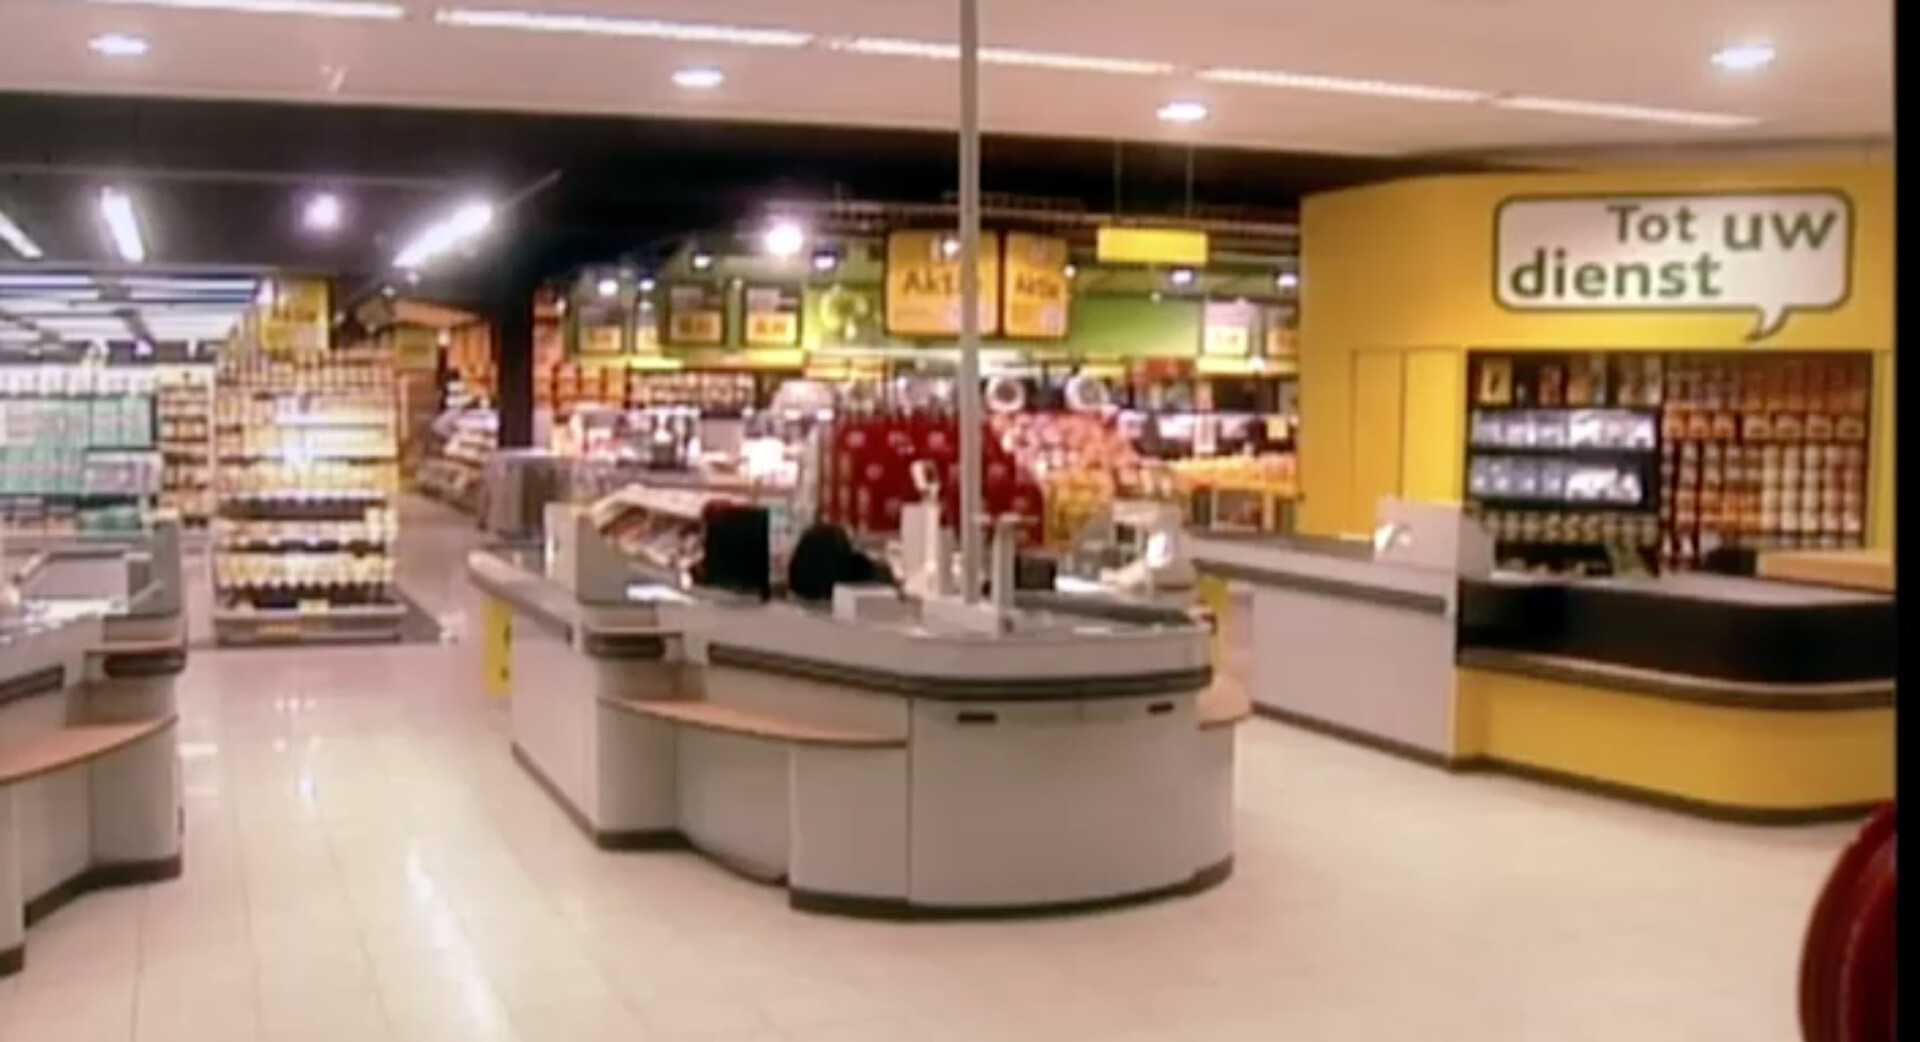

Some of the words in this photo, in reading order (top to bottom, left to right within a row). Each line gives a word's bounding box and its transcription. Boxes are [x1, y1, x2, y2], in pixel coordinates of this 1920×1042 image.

[1606, 204, 1697, 244] Tot
[1722, 209, 1838, 252] uw
[1509, 247, 1723, 298] dienst
